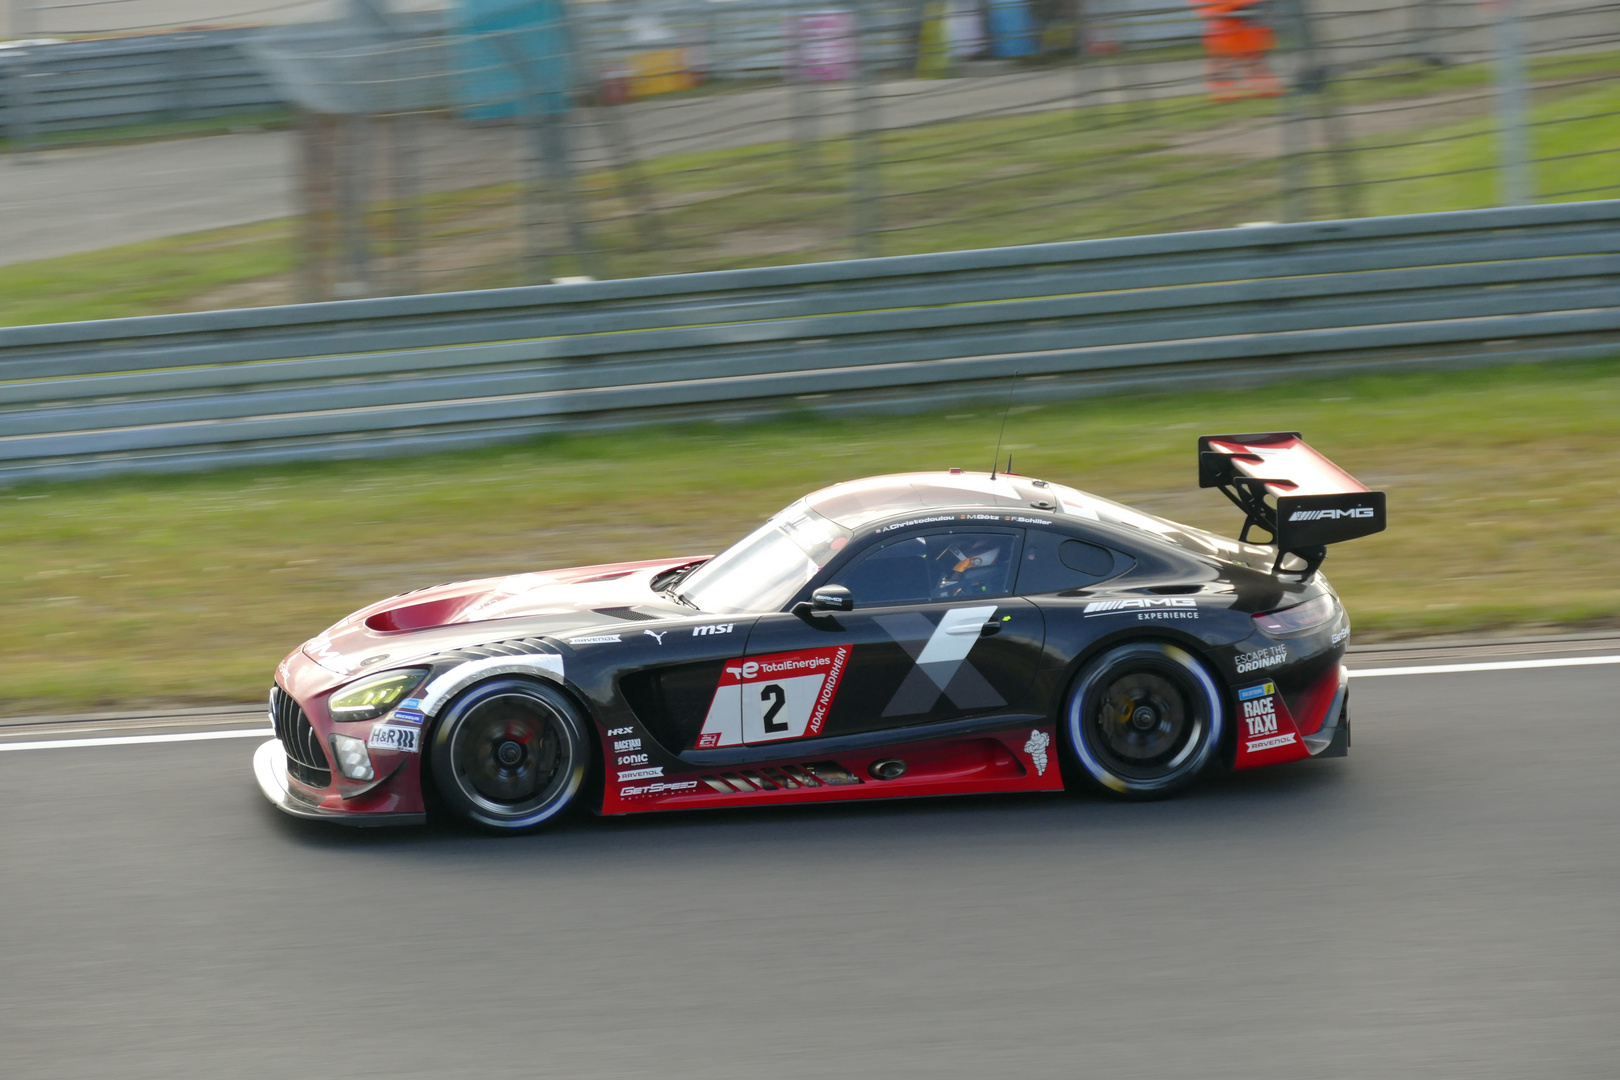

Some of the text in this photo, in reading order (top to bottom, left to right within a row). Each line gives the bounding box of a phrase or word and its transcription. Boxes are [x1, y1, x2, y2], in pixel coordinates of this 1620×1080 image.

[1316, 507, 1374, 520] AMG
[1137, 612, 1199, 620] EXPERIENCE
[692, 623, 734, 637] msi
[1234, 643, 1287, 665] ESCAPE THE
[760, 656, 831, 673] TotalEnergies
[1236, 653, 1288, 674] ORDINARY
[810, 647, 847, 733] ADAC NORDRHEIN
[760, 684, 789, 734] 2
[1243, 696, 1275, 718] RACE
[607, 726, 634, 736] HRX
[1245, 713, 1278, 735] TAXI
[371, 728, 396, 744] H&R
[621, 769, 660, 779] RAVENOL
